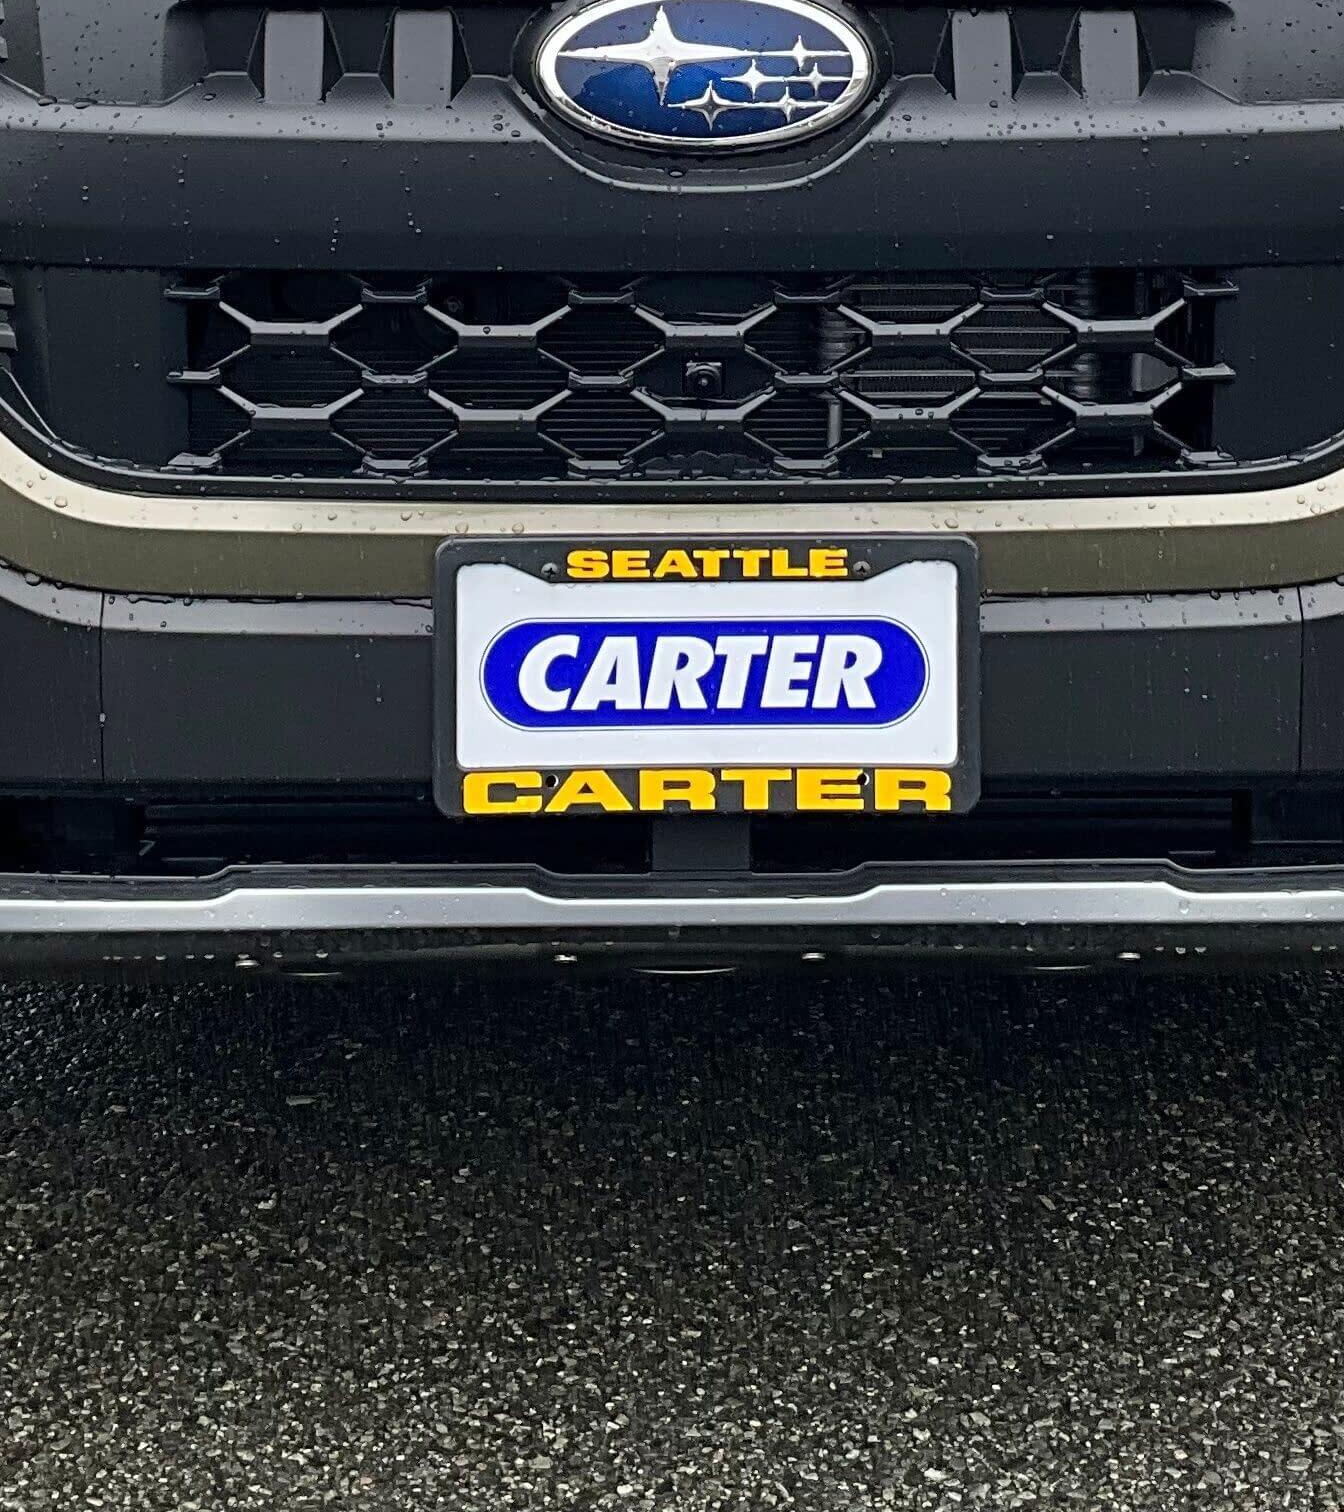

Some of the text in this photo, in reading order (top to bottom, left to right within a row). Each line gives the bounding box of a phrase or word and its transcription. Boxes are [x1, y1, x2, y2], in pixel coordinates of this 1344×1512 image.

[567, 548, 849, 579] SEATTLE
[518, 634, 883, 712] CARTER
[462, 769, 952, 815] CARTER
